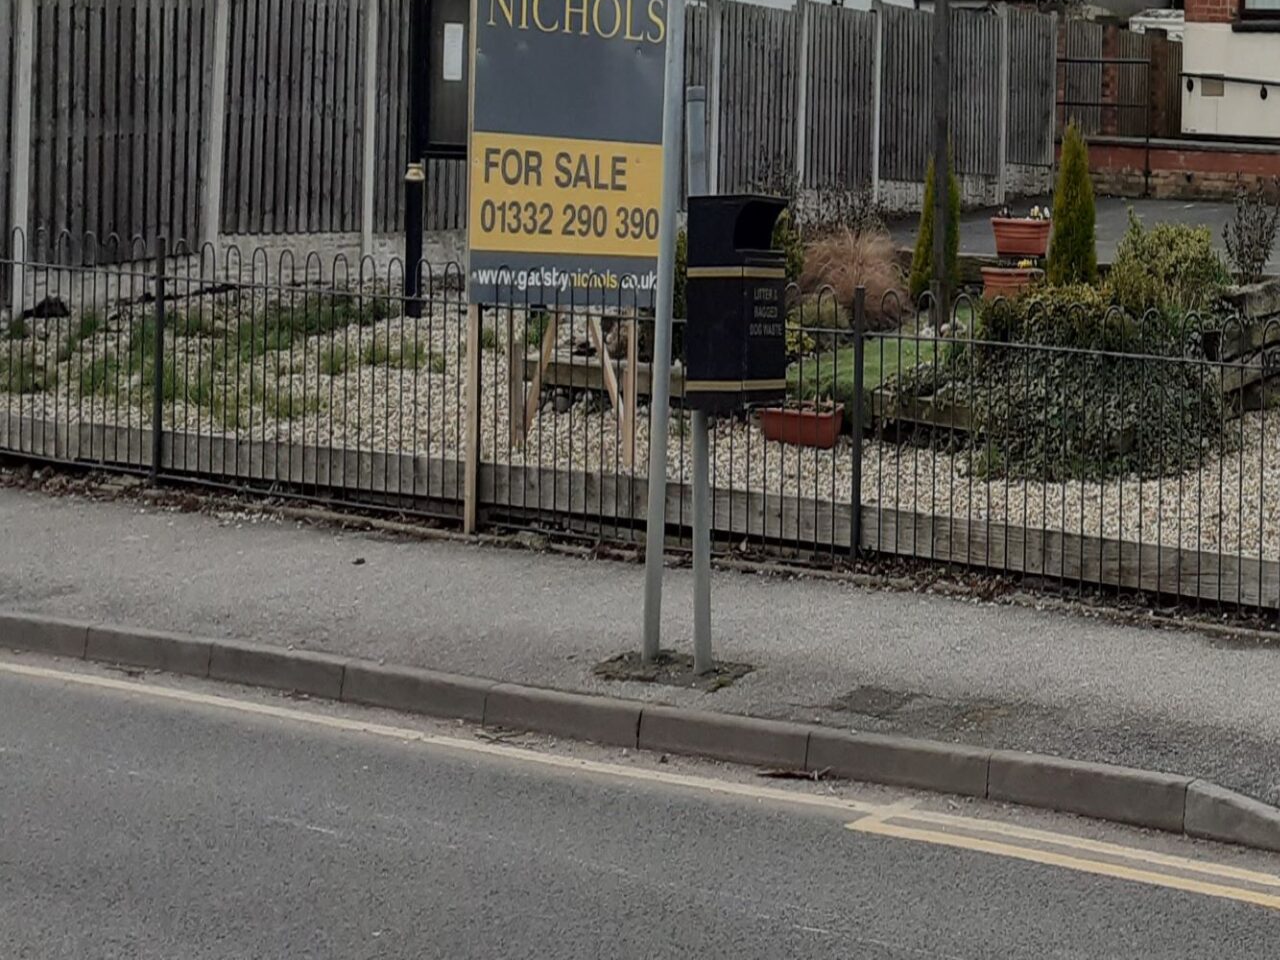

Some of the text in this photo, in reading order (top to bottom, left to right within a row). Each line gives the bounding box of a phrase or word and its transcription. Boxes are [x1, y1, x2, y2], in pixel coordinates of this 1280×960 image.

[484, 147, 627, 191] FOR SALE
[480, 199, 660, 240] 01332 290 390
